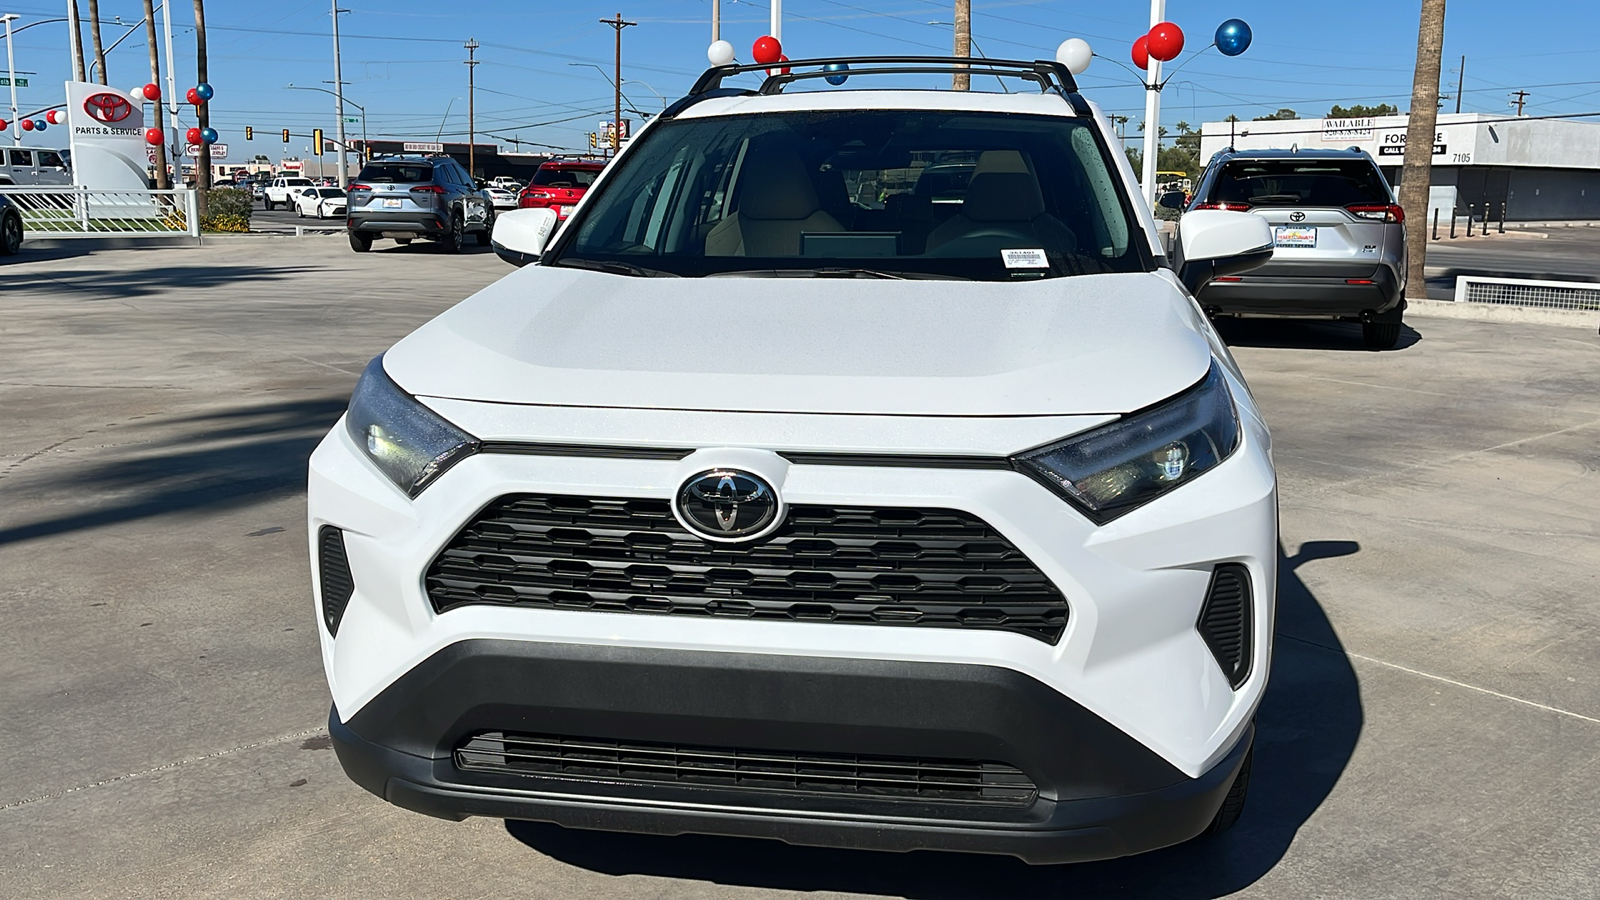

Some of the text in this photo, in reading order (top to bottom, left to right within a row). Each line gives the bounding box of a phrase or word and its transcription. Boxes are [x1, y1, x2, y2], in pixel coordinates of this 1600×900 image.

[1323, 119, 1374, 128] AVAILABLE
[75, 126, 142, 136] PARTS & SERVICE
[1385, 134, 1407, 144] FOR
[1453, 153, 1471, 163] 7105
